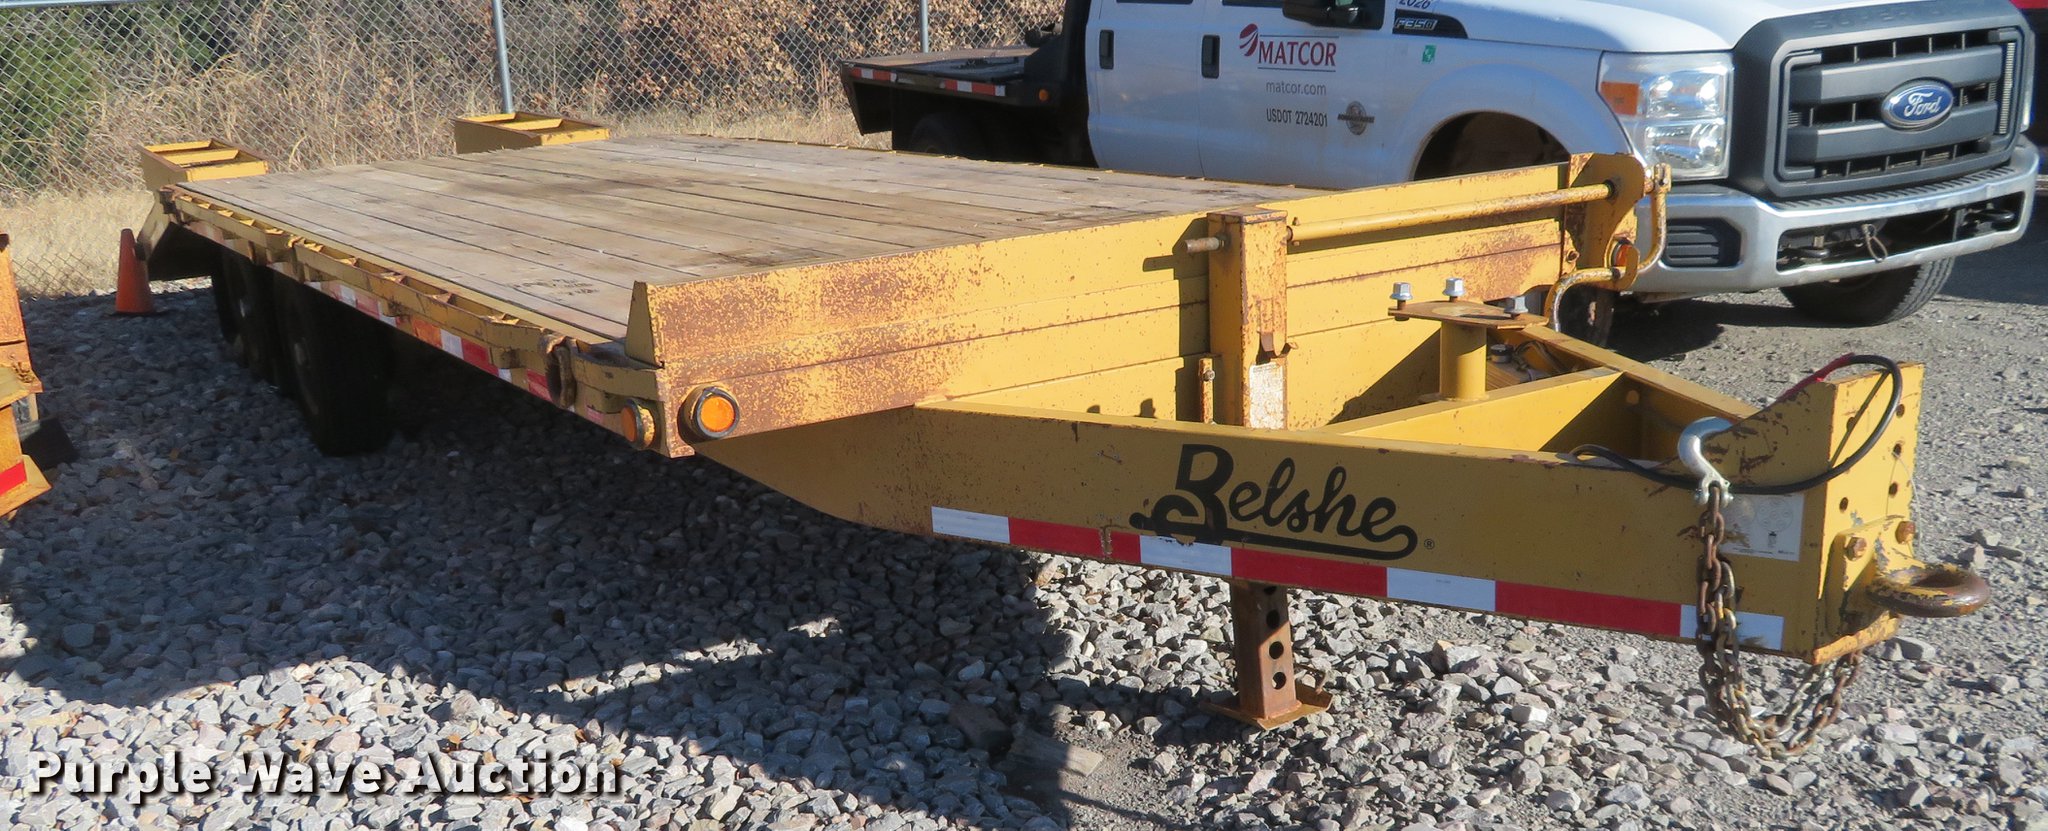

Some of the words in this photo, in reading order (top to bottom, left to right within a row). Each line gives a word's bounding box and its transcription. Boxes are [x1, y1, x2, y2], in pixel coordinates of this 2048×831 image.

[1258, 41, 1337, 67] MATCOR
[1266, 81, 1327, 95] matcor.com
[1266, 108, 1292, 124] USDOT
[1295, 111, 1328, 127] 2724201
[1903, 92, 1941, 118] Ford
[1130, 444, 1418, 560] Belshe
